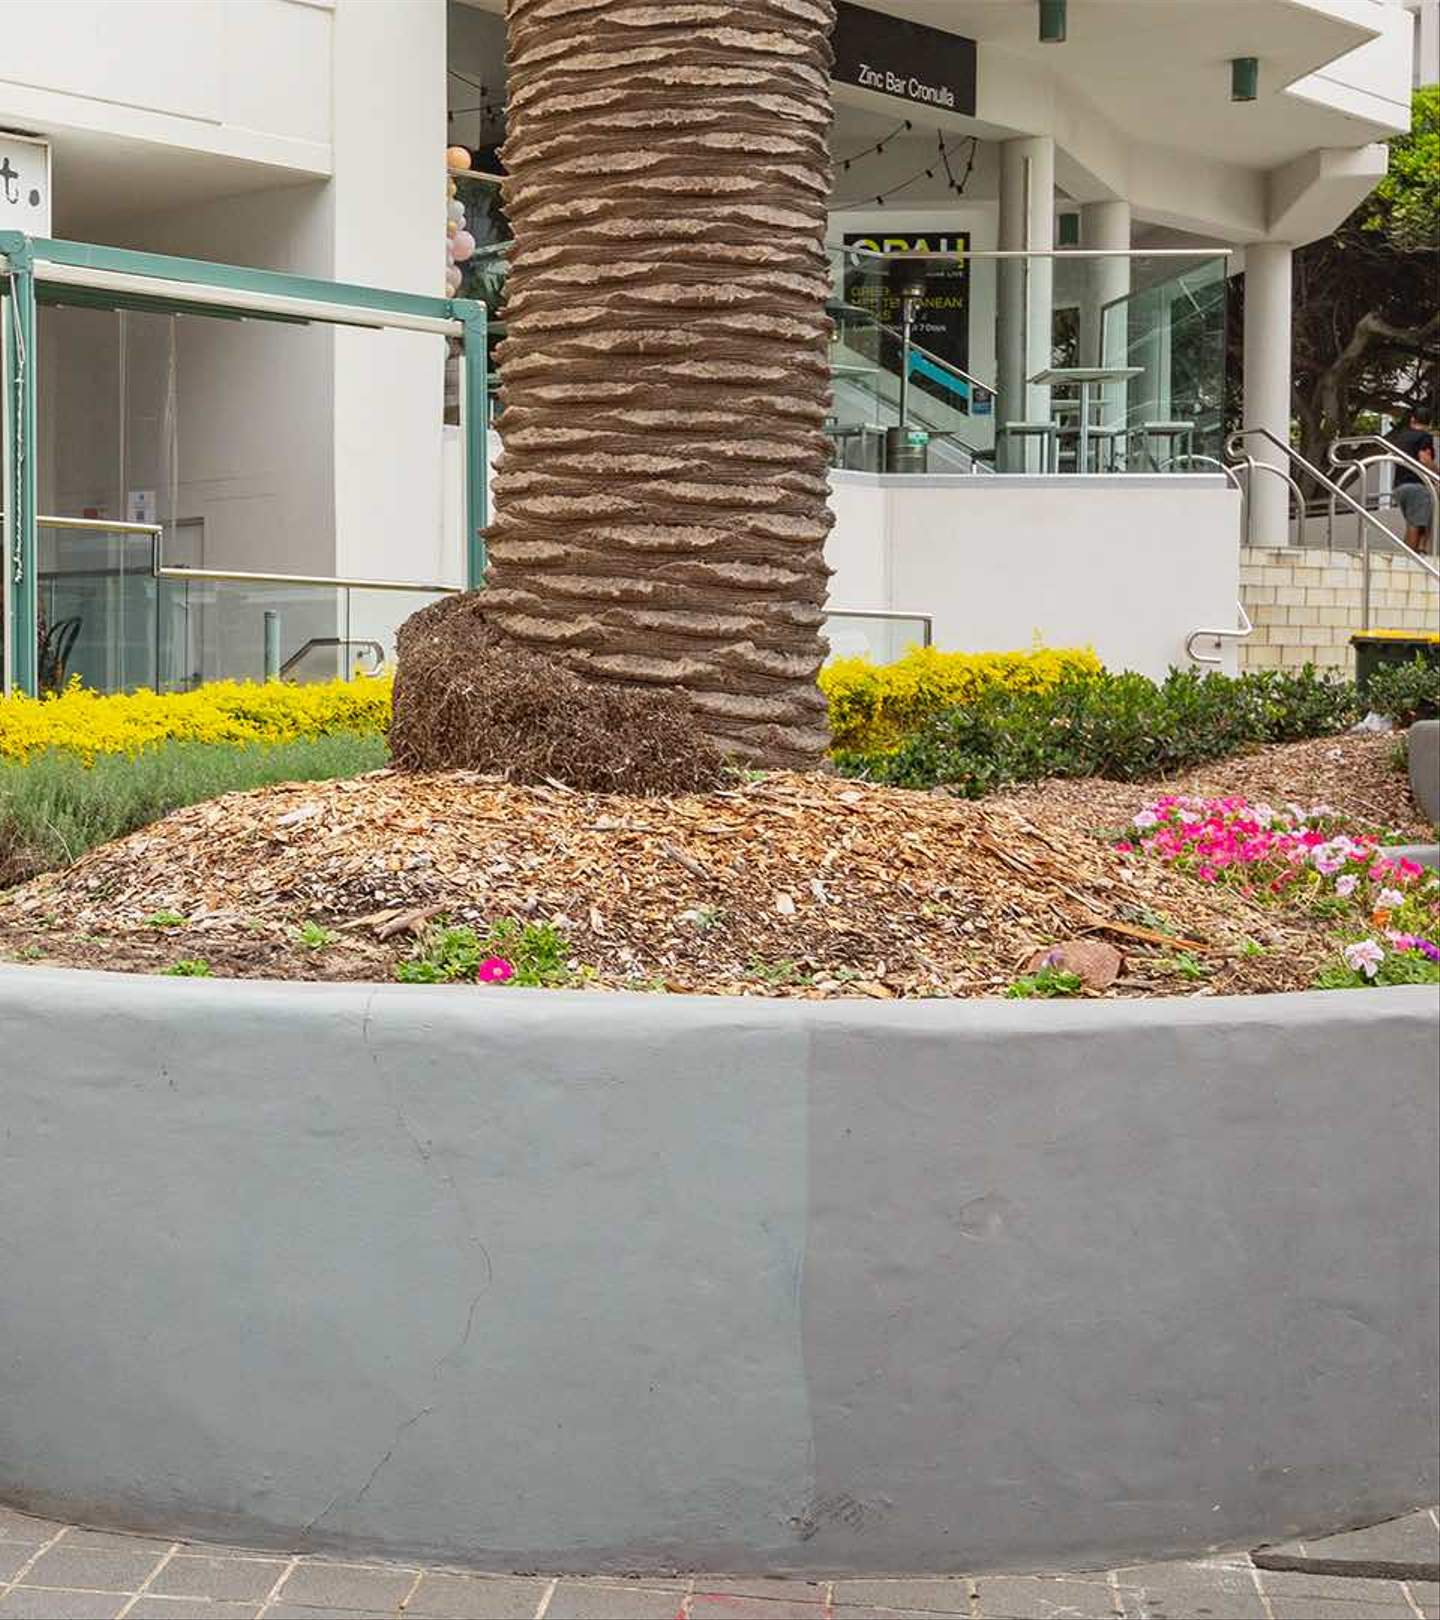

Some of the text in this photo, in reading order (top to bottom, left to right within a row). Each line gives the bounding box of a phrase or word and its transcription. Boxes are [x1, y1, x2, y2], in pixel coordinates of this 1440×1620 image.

[858, 63, 954, 106] Zinc Bar Cronulla
